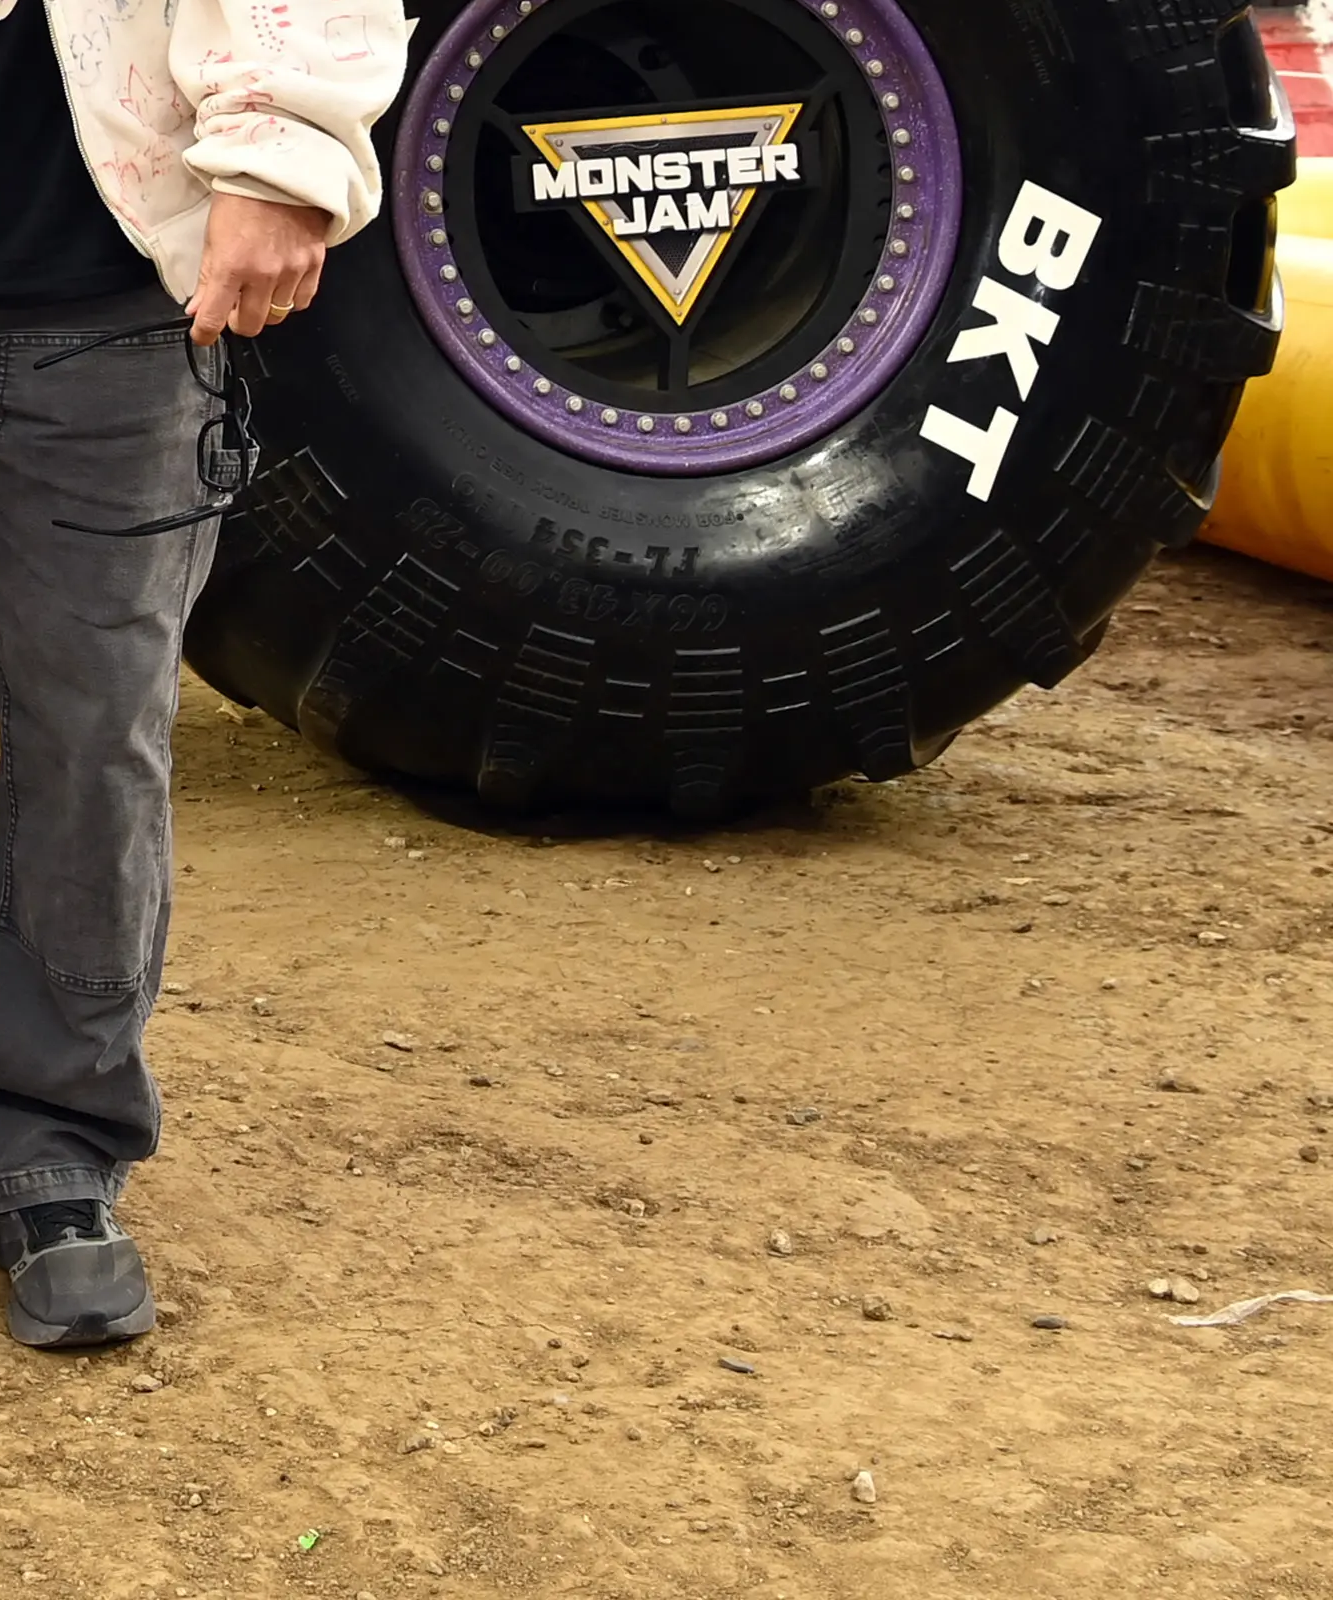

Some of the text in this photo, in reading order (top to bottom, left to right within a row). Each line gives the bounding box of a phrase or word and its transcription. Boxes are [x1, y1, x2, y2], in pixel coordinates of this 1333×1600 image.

[532, 142, 801, 201] MONSTER
[611, 193, 734, 237] JAM
[919, 179, 1103, 503] BKT
